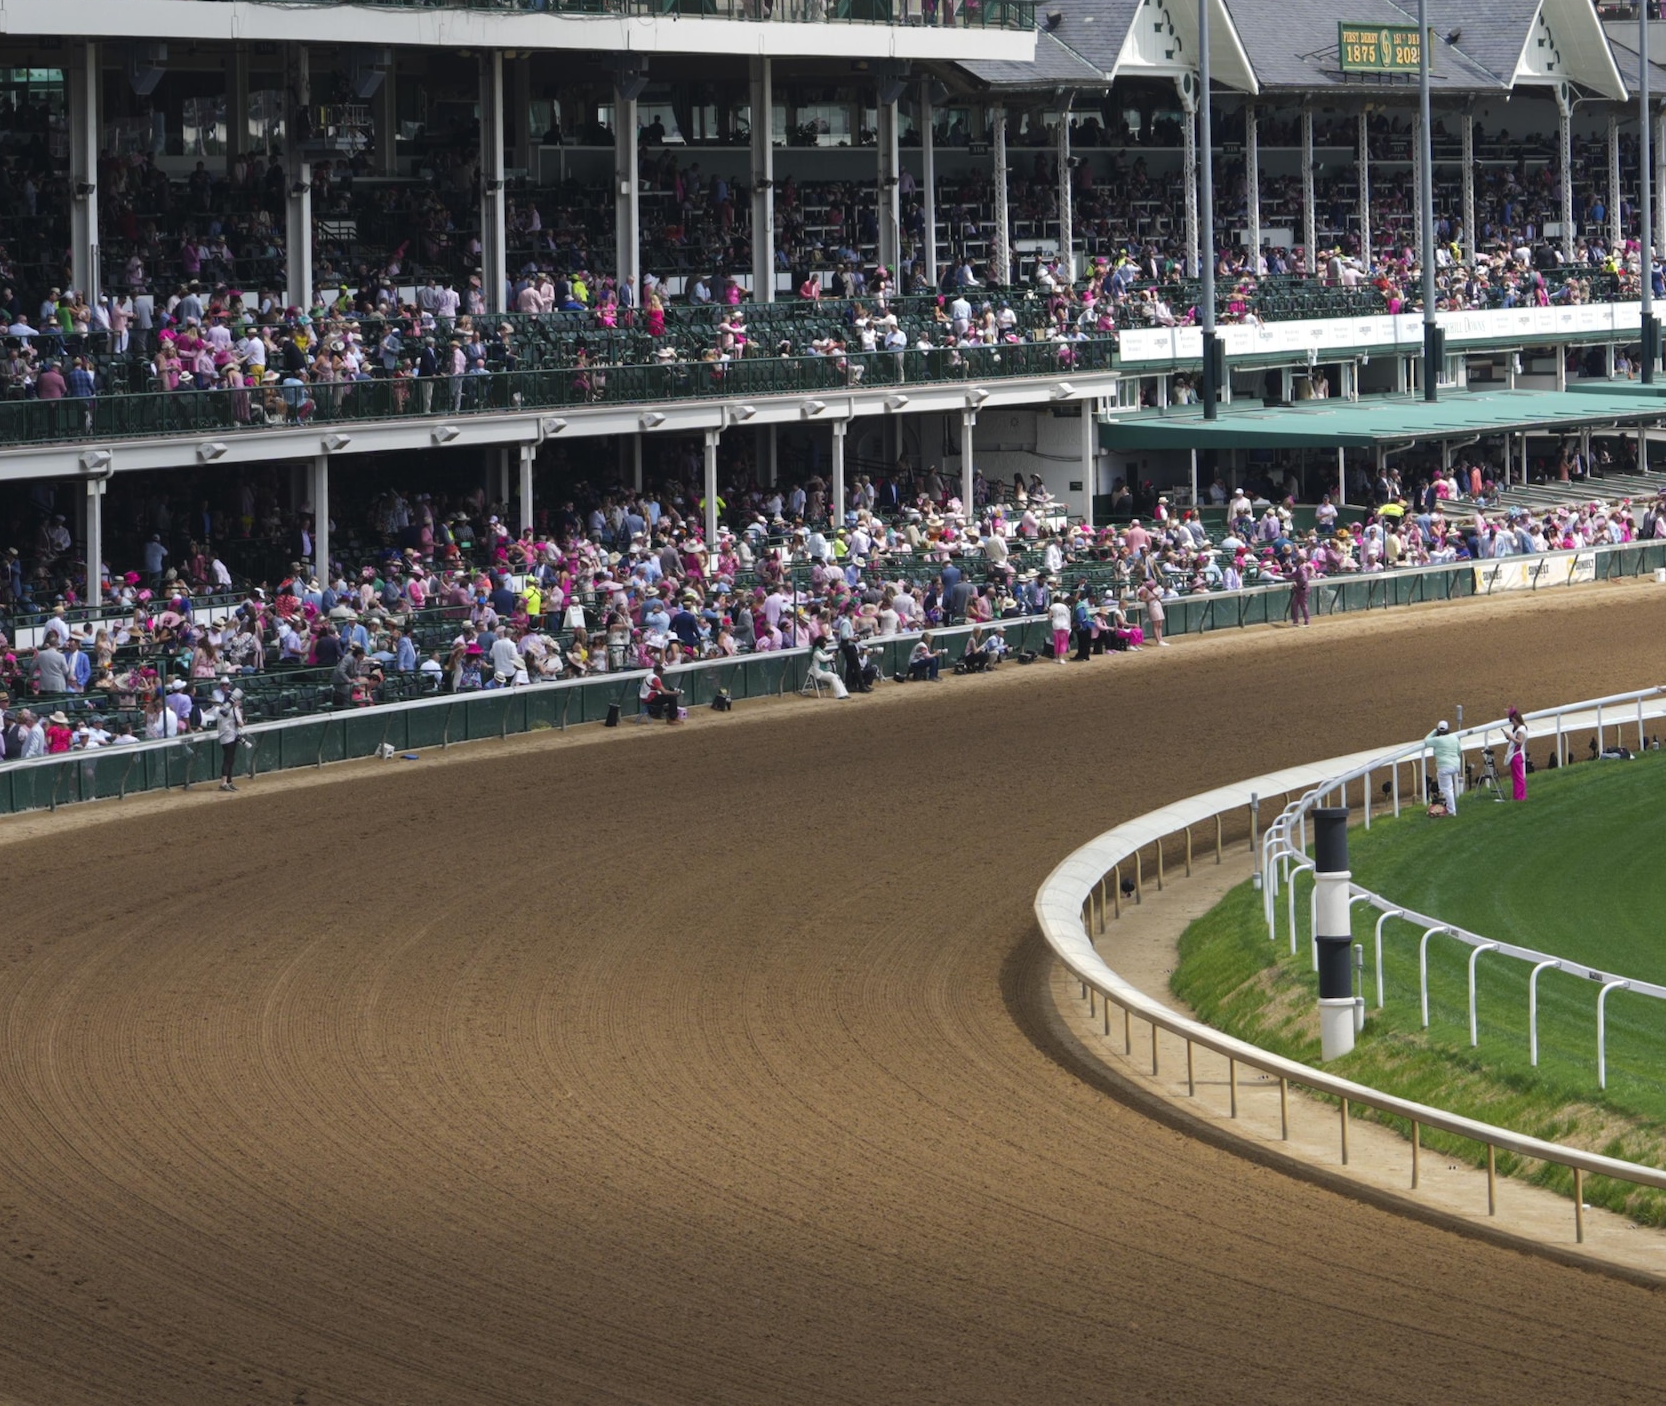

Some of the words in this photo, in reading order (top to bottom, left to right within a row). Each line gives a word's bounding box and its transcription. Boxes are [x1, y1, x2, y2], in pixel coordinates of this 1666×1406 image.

[1343, 32, 1359, 42] FIRST
[1361, 32, 1378, 43] DERBY
[1347, 46, 1376, 63] 1875
[1396, 47, 1420, 64] 202
